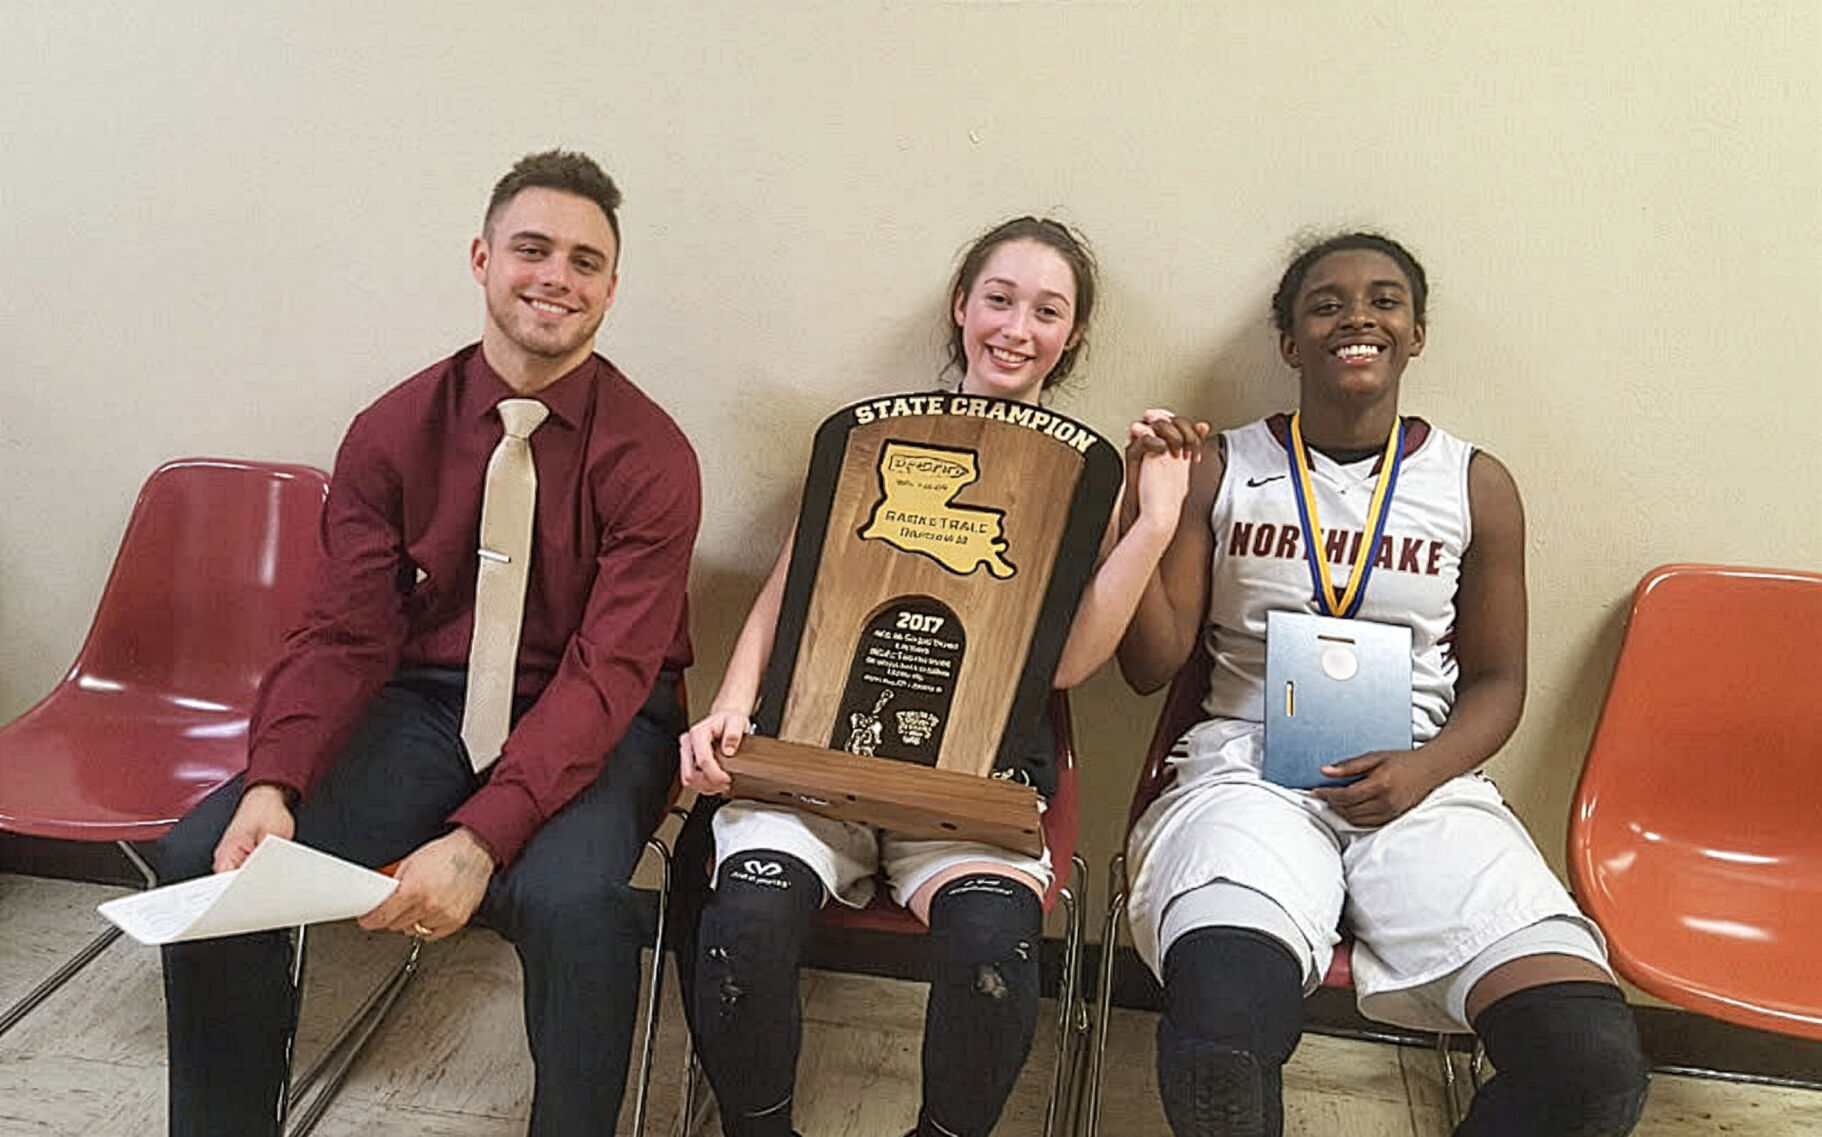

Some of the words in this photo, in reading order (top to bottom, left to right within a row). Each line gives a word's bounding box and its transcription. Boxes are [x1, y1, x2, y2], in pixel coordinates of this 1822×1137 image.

[854, 396, 945, 425] STATE
[950, 397, 1098, 453] CHAMPION
[1228, 521, 1444, 576] NORHLAKE
[896, 611, 945, 634] 2017
